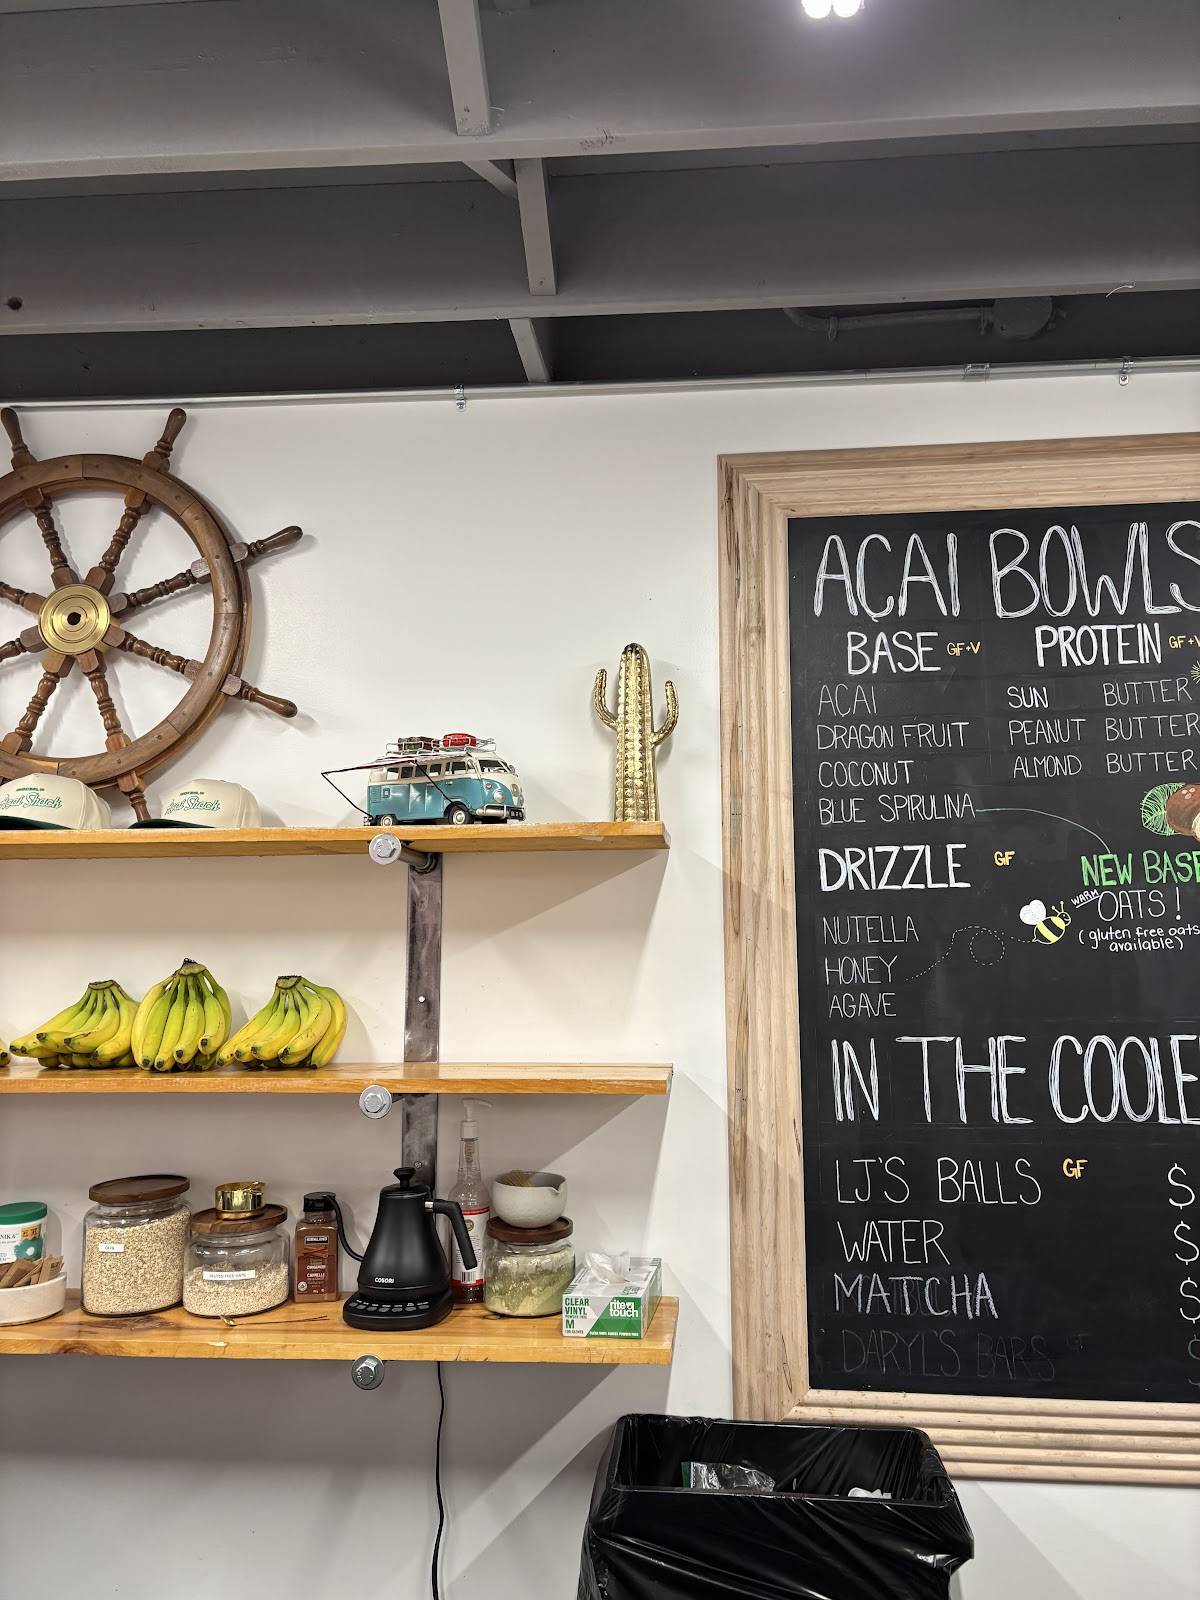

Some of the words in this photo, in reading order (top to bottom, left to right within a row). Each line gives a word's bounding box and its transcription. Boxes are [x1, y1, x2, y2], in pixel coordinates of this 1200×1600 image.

[989, 519, 1200, 618] BOWLS
[847, 631, 941, 675] BASE
[1035, 623, 1162, 668] PROTEIN
[1007, 686, 1049, 709] SUN
[1103, 677, 1192, 707] BUTTER
[817, 724, 894, 750] DRAGON
[902, 722, 970, 748] FRUIT
[1008, 718, 1087, 746] PEANUT
[1105, 712, 1200, 742] BUTTER
[818, 760, 914, 787] COCONUT
[1013, 754, 1082, 779] ALMOND
[1106, 749, 1198, 774] BUTTER
[819, 798, 866, 825] BLUE
[878, 793, 976, 823] SPIRULINA
[818, 844, 971, 891] DRIZZLE
[993, 851, 1016, 867] GF
[1081, 853, 1132, 886] NEW
[1071, 889, 1099, 908] WARM
[1098, 890, 1166, 921] OATS
[823, 915, 920, 945] NUTELLA
[1135, 926, 1165, 938] free
[1168, 923, 1200, 937] oats
[824, 955, 898, 985] HONEY
[829, 993, 898, 1018] AGAVE
[831, 1038, 879, 1122] IN
[896, 1035, 1035, 1124] THE
[1048, 1034, 1200, 1125] COOLE
[835, 1156, 910, 1204] LJ'S
[936, 1156, 1042, 1205] BALLS
[1062, 1157, 1088, 1179] GF
[837, 1219, 950, 1265] WATER
[564, 1297, 590, 1307] CLEAR
[609, 1299, 627, 1309] rite
[833, 1272, 999, 1319] MATCHA
[564, 1306, 587, 1316] VINYL
[565, 1319, 575, 1329] M
[609, 1308, 639, 1318] touch
